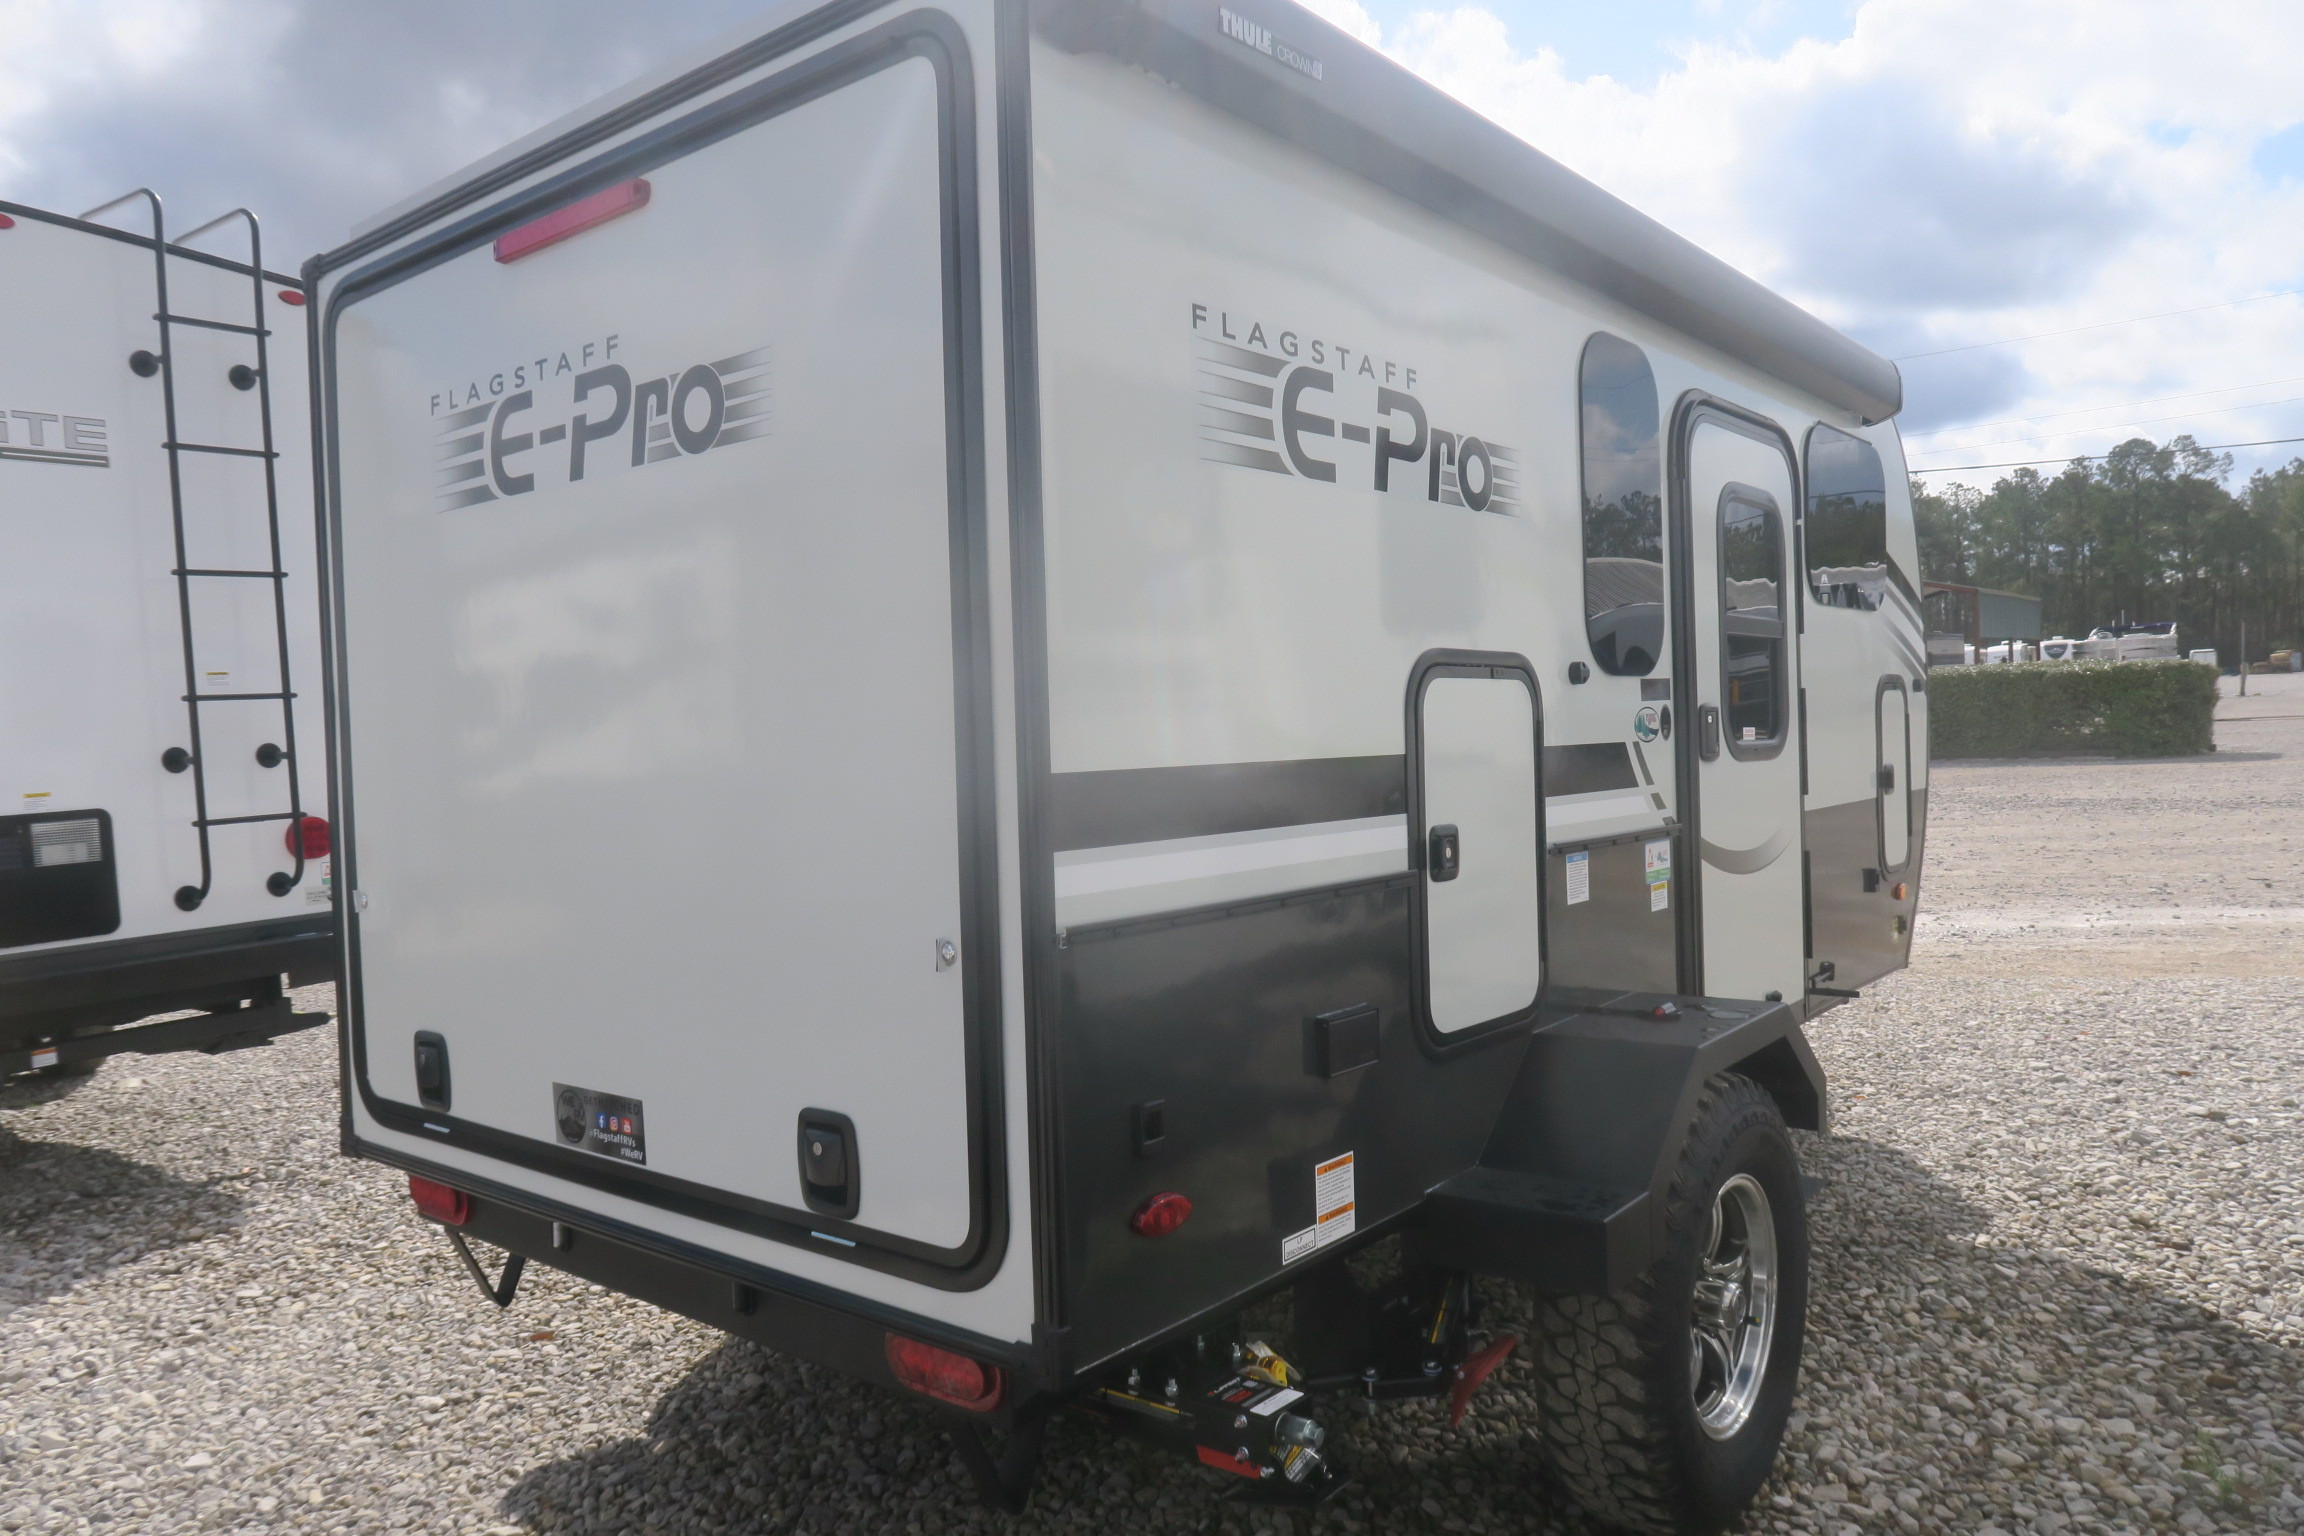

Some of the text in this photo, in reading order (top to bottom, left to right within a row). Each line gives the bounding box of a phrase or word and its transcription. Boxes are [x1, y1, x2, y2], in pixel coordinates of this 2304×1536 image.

[1220, 7, 1272, 55] THULE
[430, 334, 619, 416] FLAGSTAFF
[1192, 303, 1417, 390] FLAGSTAFF
[1286, 1241, 1314, 1257] DISCONNECT
